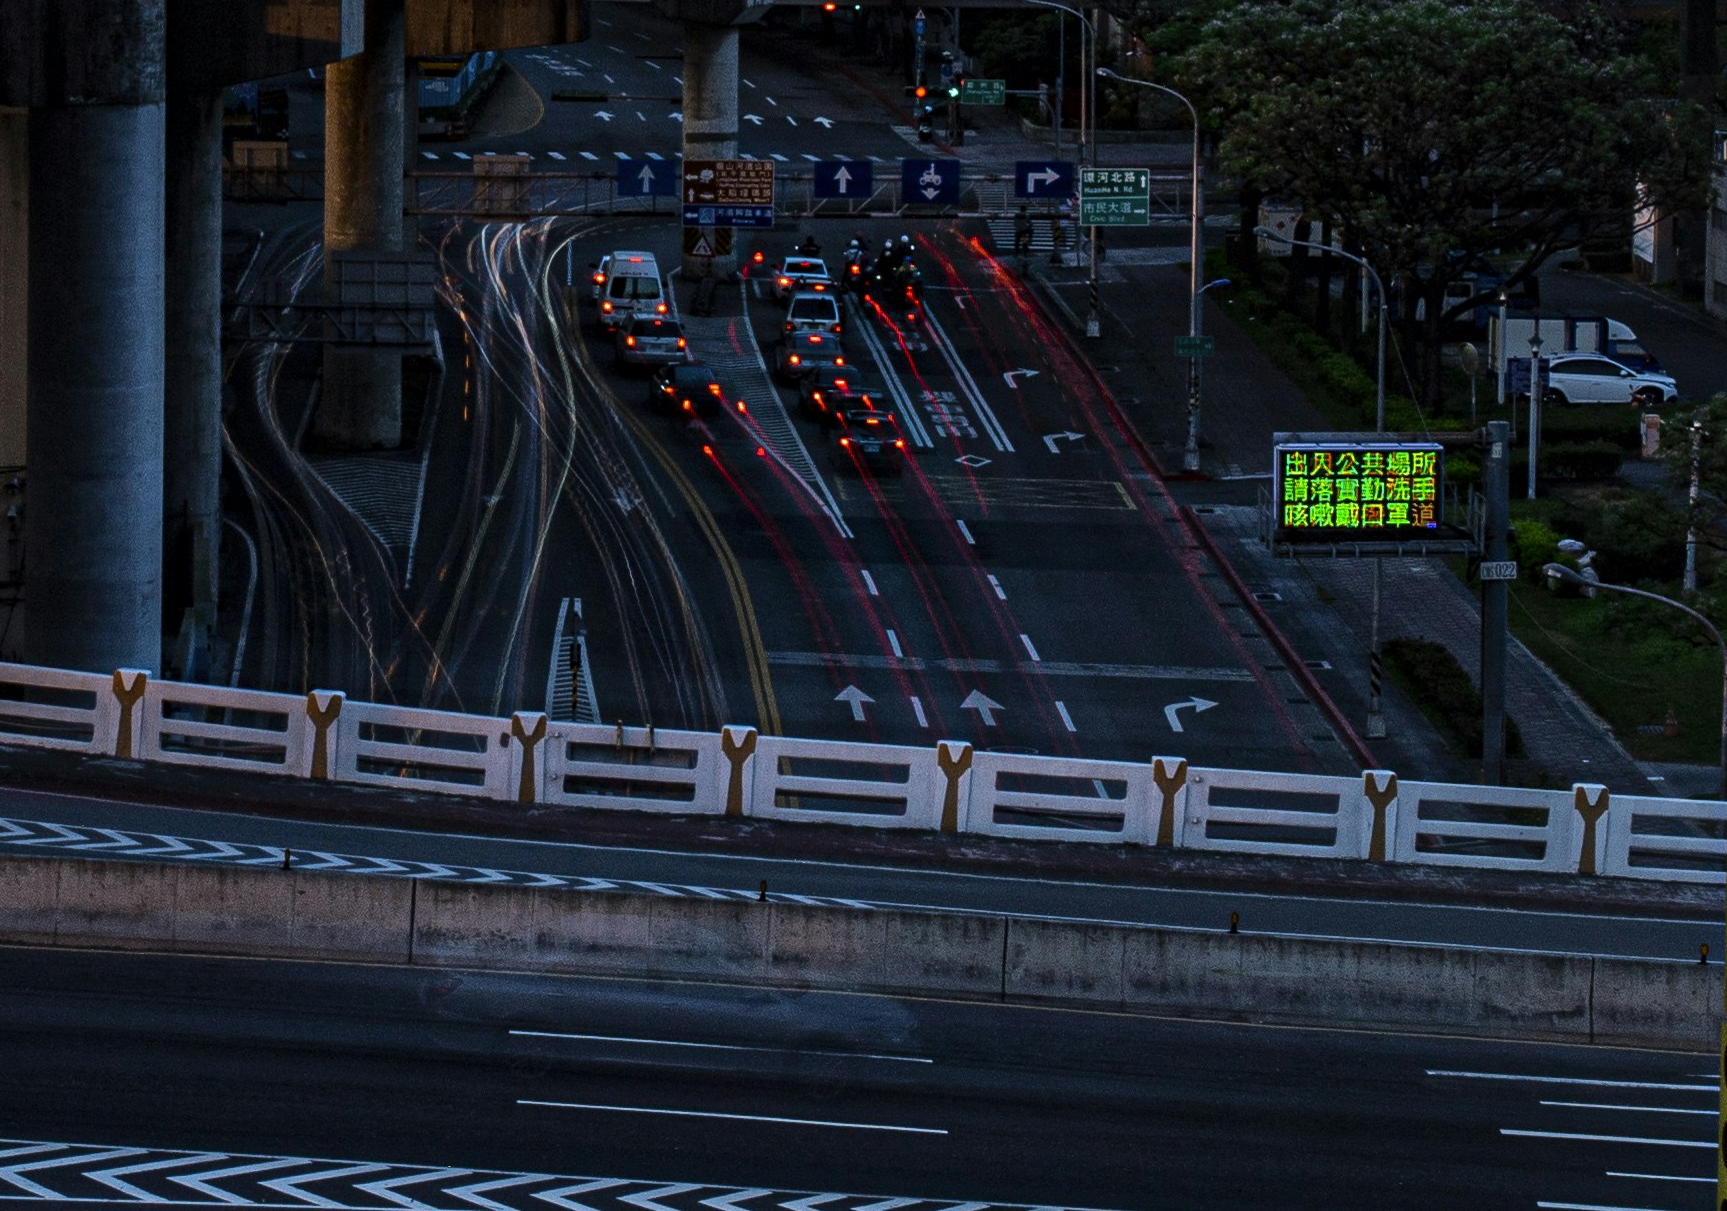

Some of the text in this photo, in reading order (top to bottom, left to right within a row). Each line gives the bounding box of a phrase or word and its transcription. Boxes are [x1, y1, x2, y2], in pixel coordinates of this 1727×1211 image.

[1083, 171, 1135, 184] 環河北路
[1084, 202, 1132, 214] 市民大道
[1286, 451, 1437, 476] 出入公共場所
[1284, 476, 1436, 502] 請落實勤洗手
